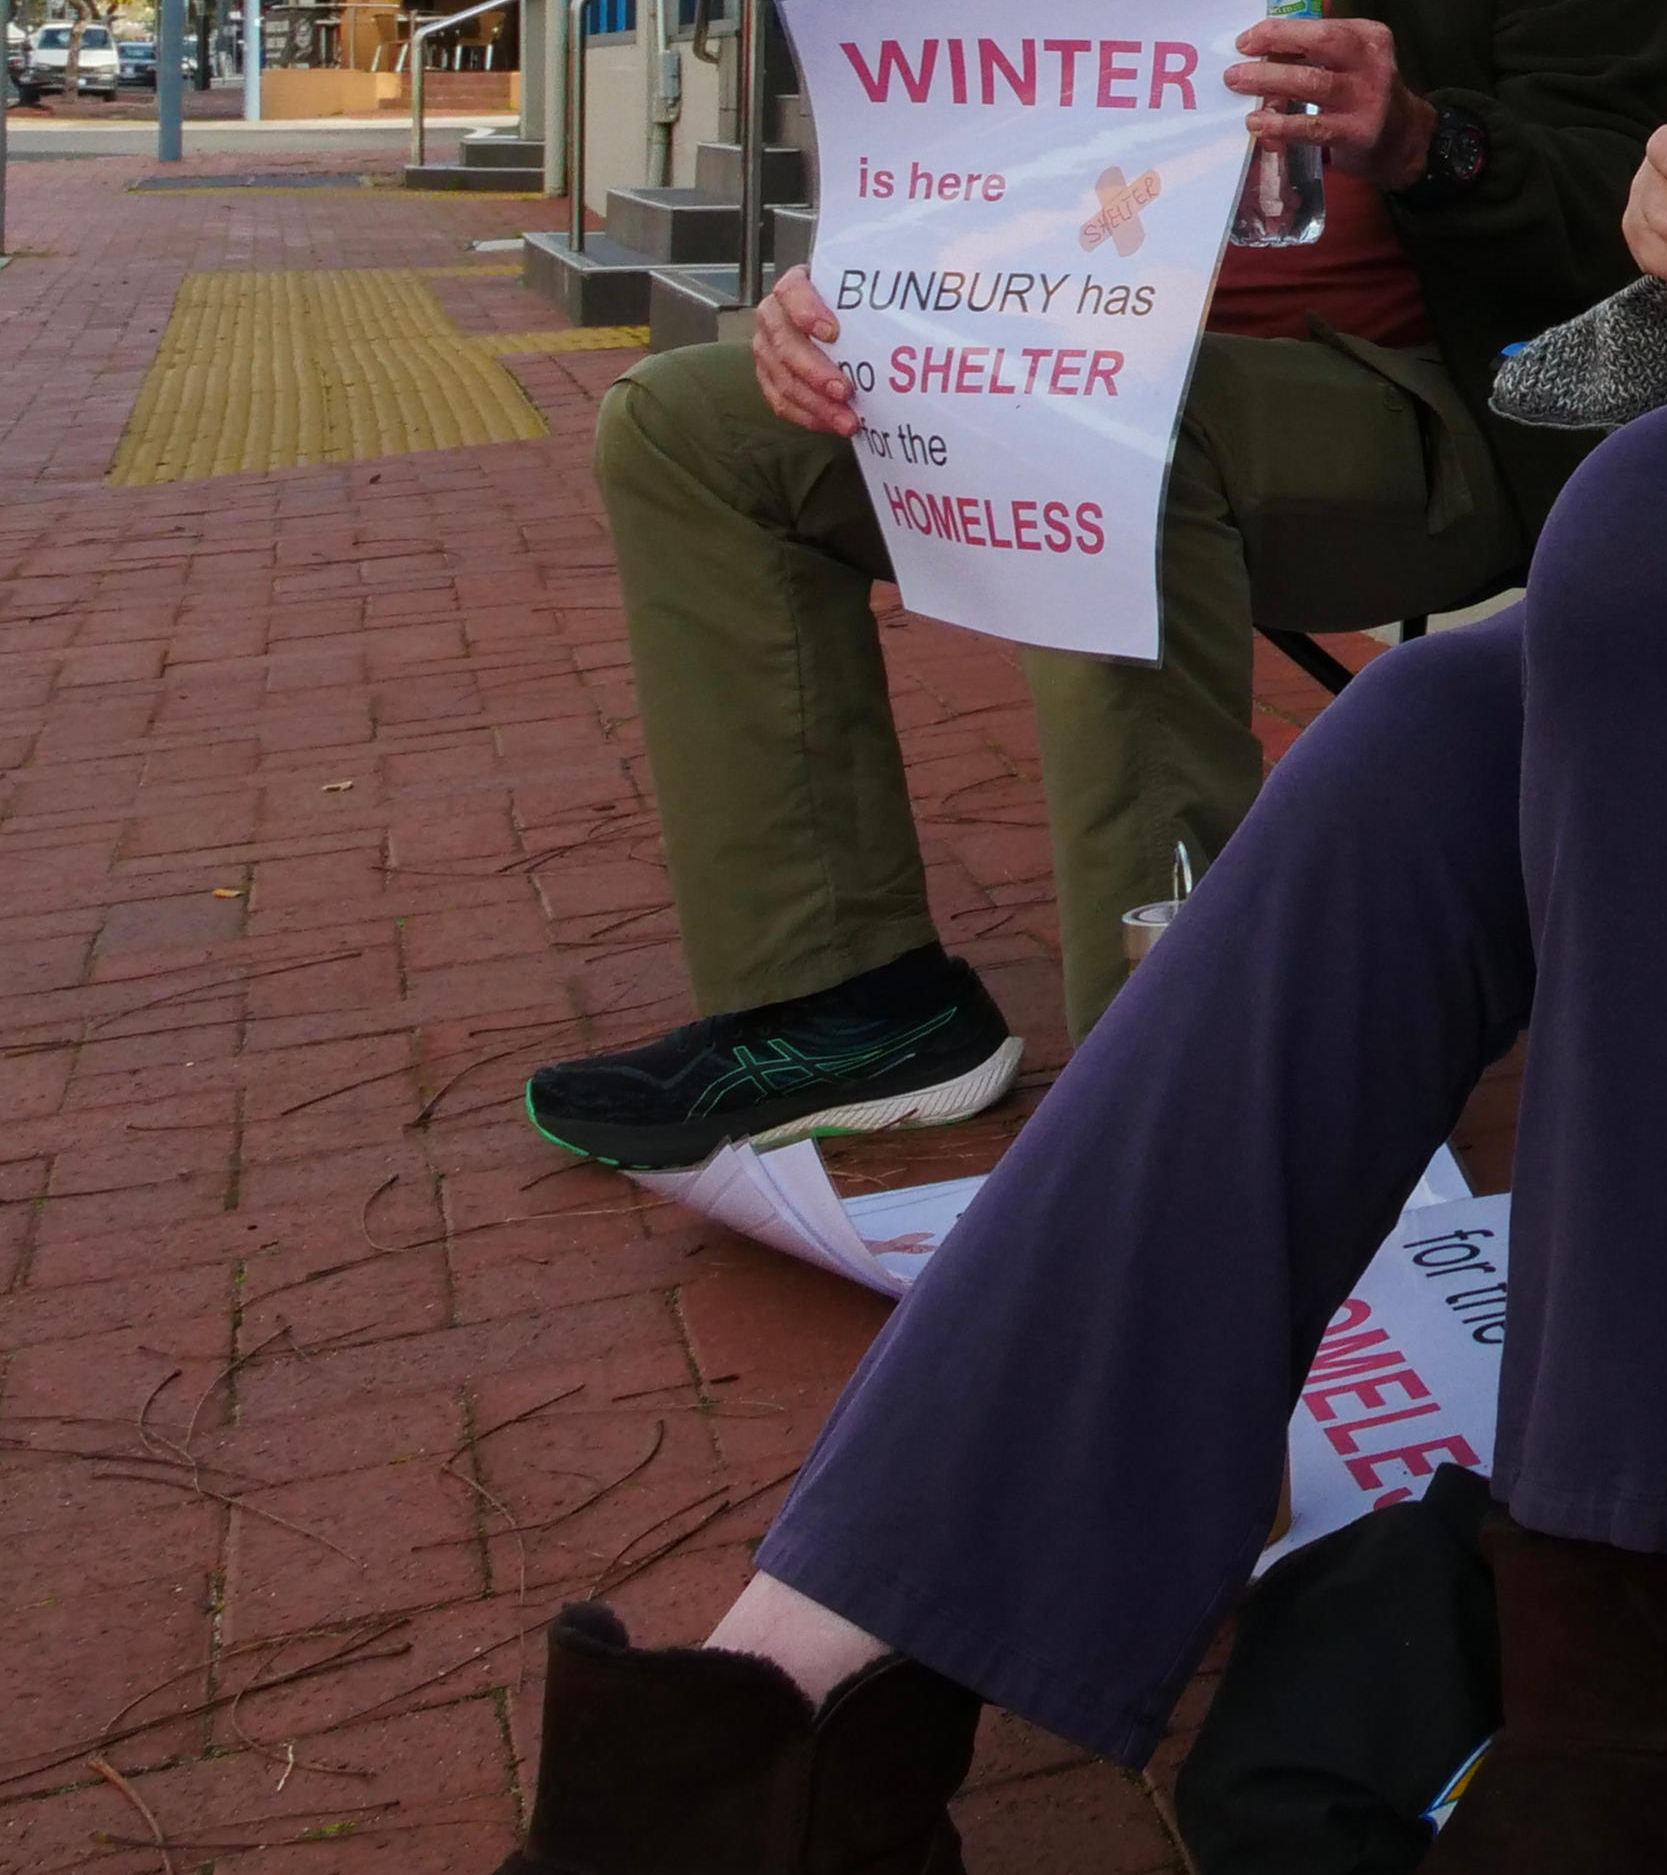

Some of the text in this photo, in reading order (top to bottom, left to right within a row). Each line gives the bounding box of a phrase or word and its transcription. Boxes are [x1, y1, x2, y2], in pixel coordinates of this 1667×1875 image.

[840, 38, 1199, 110] WINTER
[858, 158, 1006, 202] is here
[1083, 177, 1159, 244] SHELTER
[837, 269, 1156, 317] BUNBURY has
[838, 345, 1124, 396] no SHELTER
[859, 416, 948, 467] for the
[883, 482, 1105, 555] HOMELESS
[1403, 1229, 1497, 1278] for
